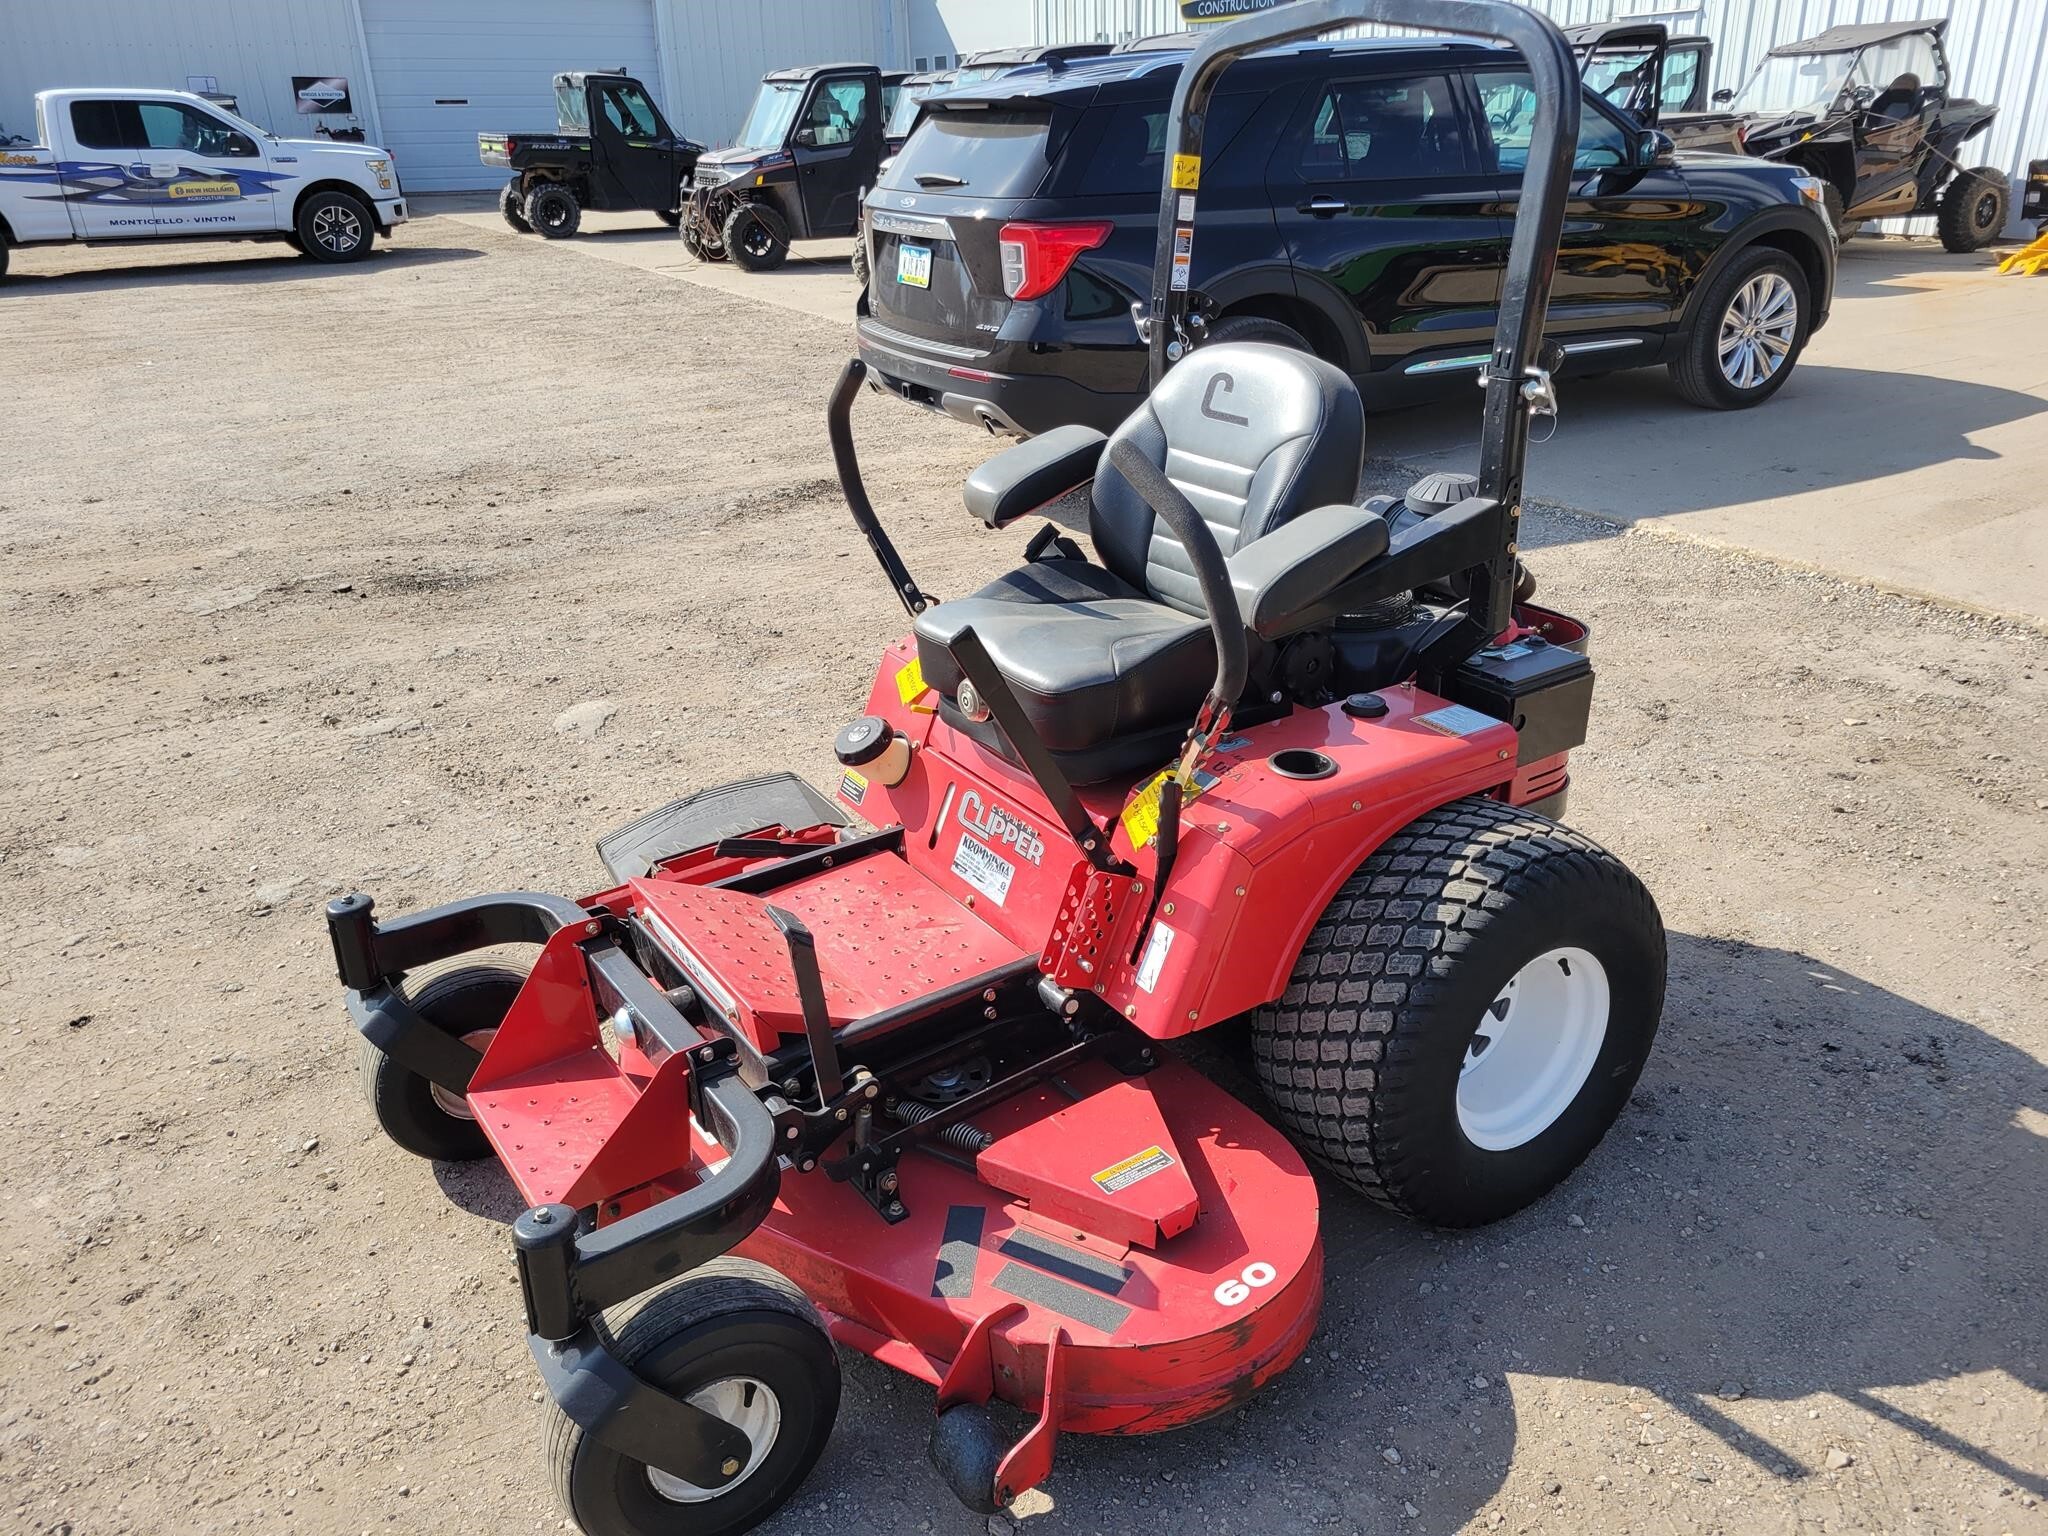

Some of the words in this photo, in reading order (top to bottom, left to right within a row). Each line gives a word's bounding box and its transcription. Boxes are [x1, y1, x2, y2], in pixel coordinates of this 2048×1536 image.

[203, 184, 235, 193] HOLLAND
[109, 217, 184, 226] MONTICELLO
[193, 215, 236, 223] VINTON
[957, 789, 1045, 867] CLIPPER
[962, 835, 1011, 877] KROMMINGA
[1213, 1261, 1277, 1307] 60
